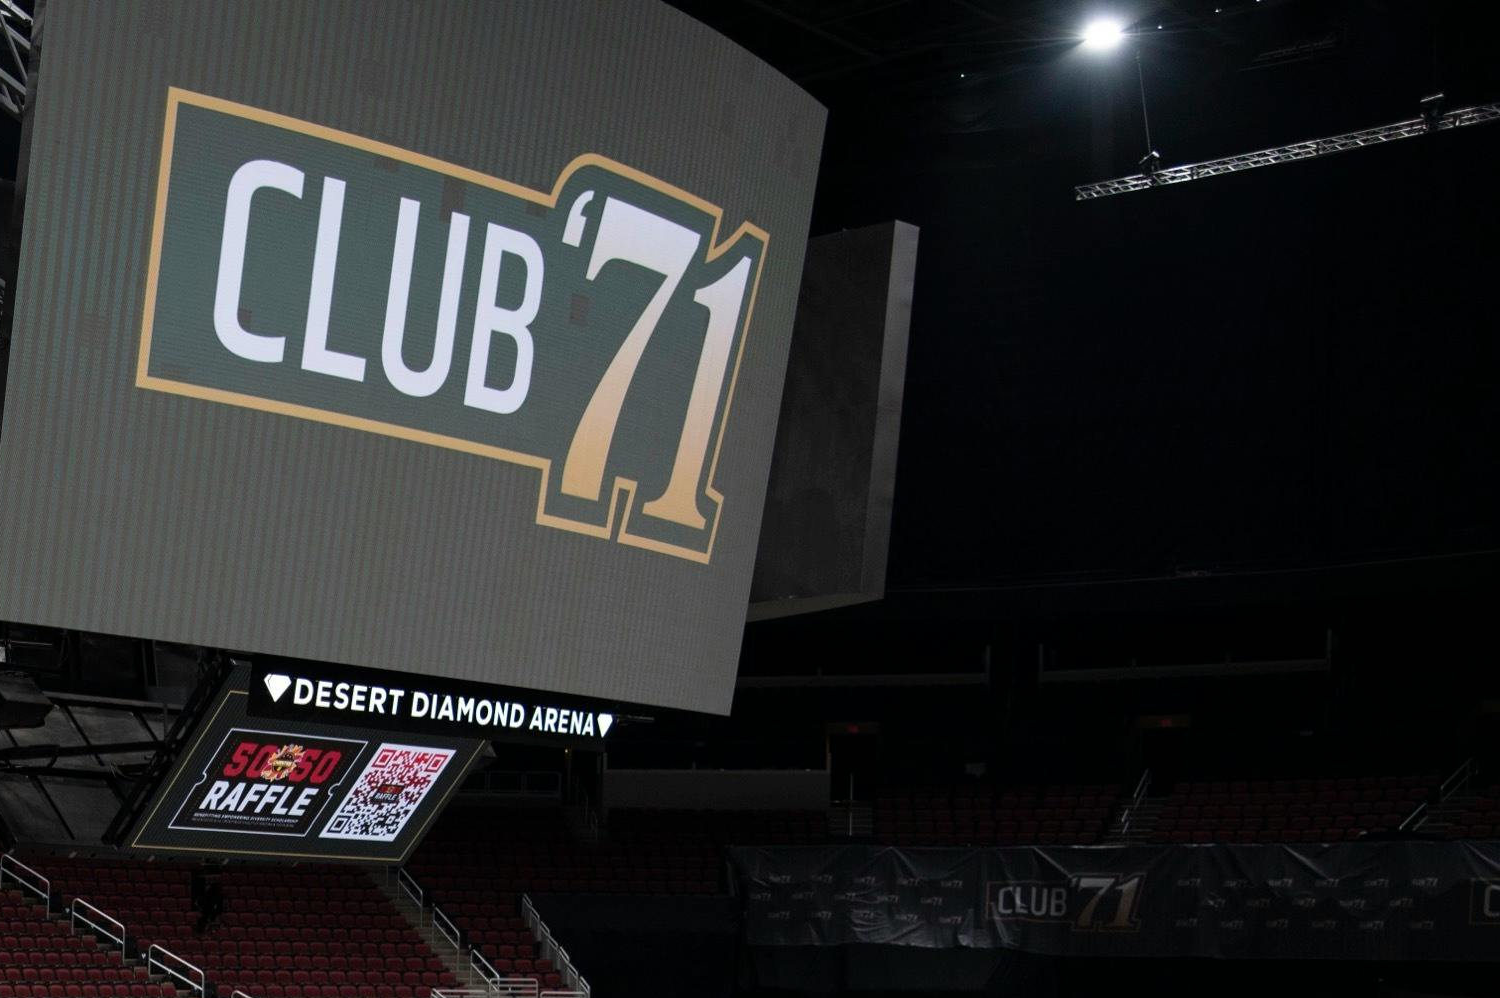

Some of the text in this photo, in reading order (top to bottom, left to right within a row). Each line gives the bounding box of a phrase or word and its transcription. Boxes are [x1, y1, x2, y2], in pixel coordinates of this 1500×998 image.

[213, 159, 752, 529] CLUB '71
[293, 678, 595, 736] DESERT DIAMOND ARENA
[199, 780, 319, 816] RAFFLE
[998, 885, 1068, 918] CLUB
